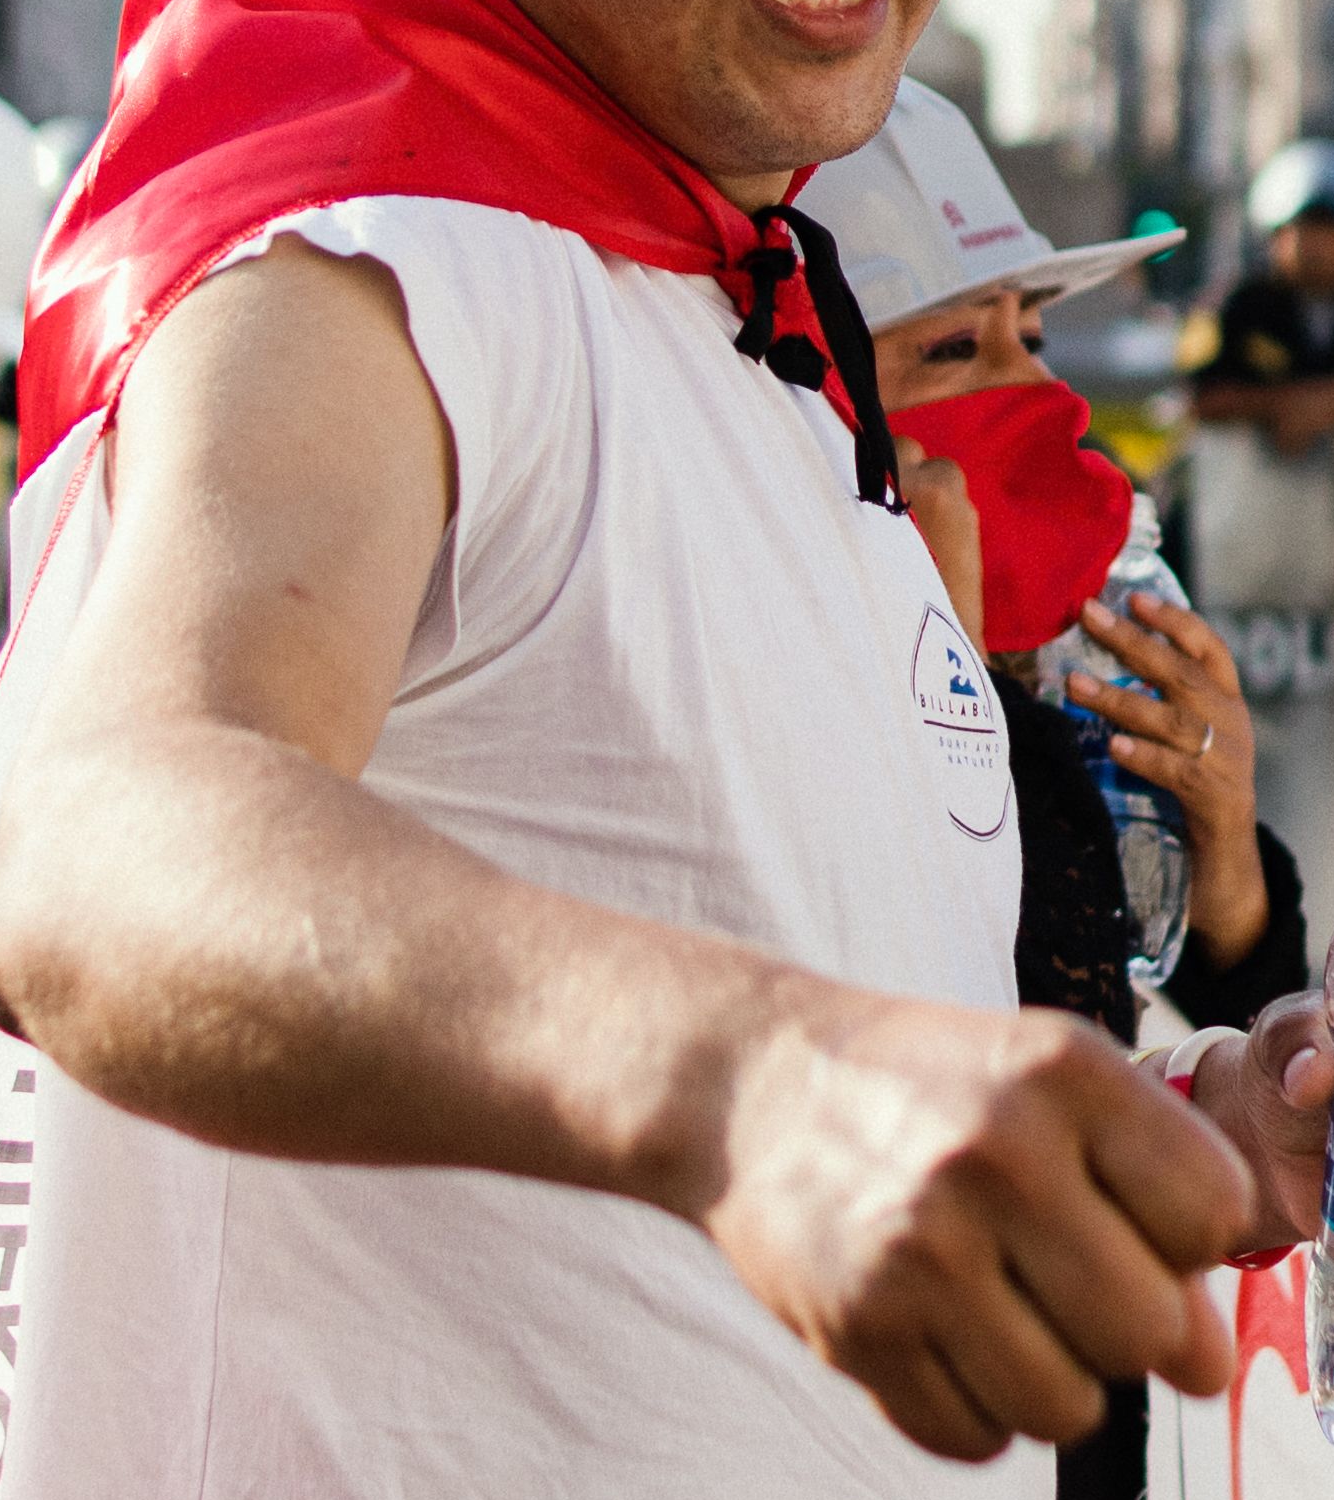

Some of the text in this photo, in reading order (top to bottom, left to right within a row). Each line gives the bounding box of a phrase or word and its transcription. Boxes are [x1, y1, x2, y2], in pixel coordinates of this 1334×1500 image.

[938, 736, 1000, 754] SURF AND
[947, 754, 994, 769] NATURE
